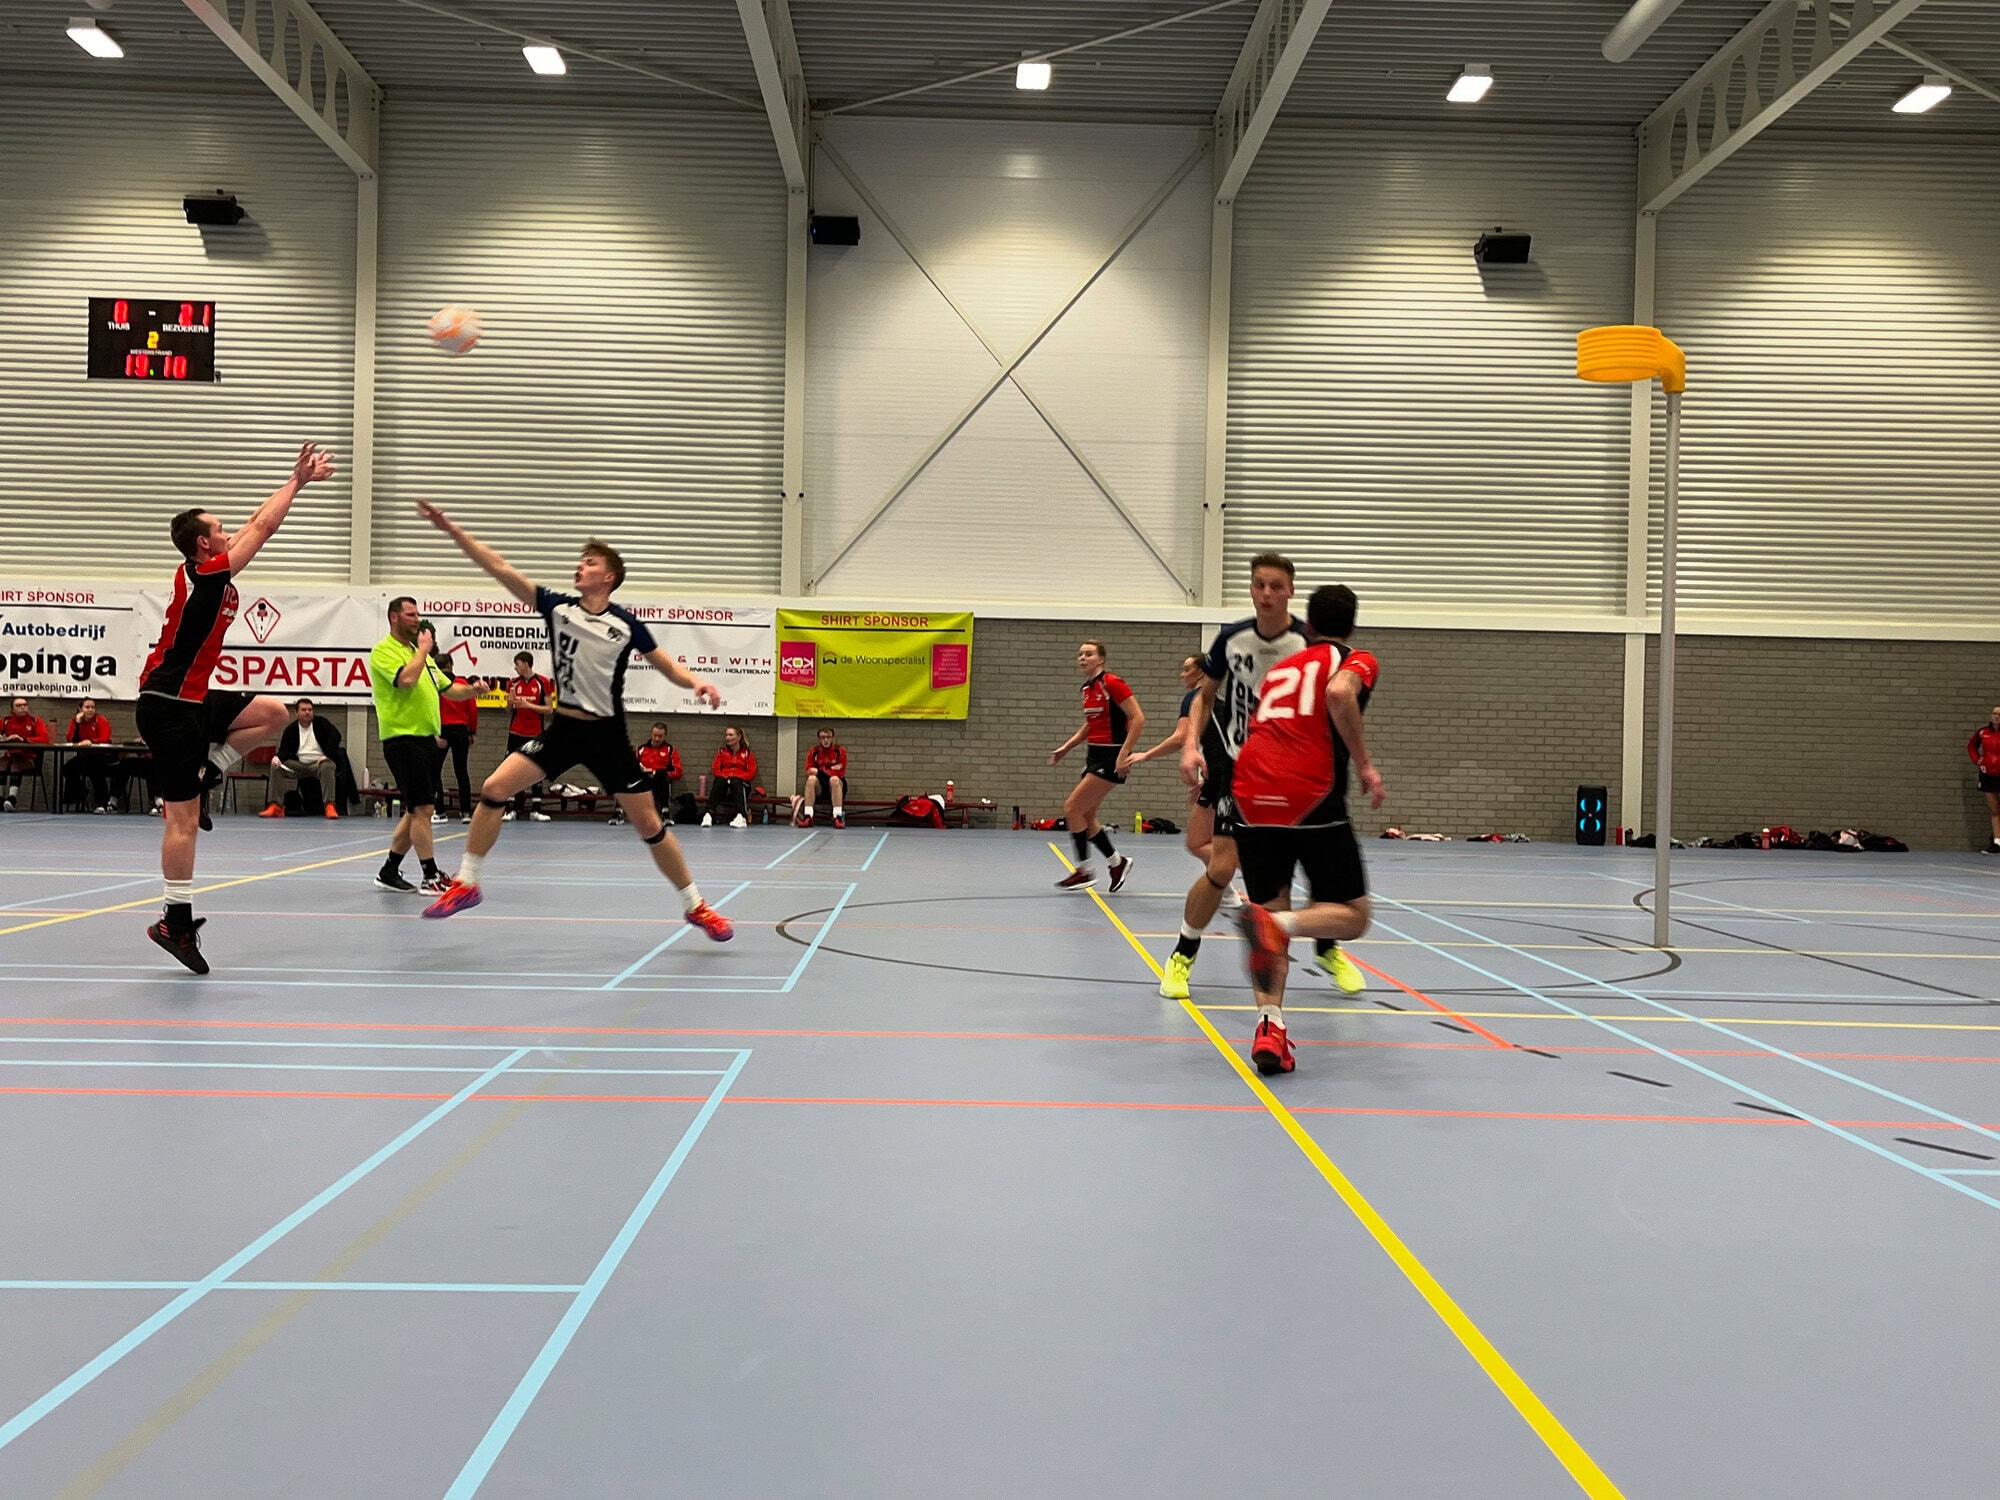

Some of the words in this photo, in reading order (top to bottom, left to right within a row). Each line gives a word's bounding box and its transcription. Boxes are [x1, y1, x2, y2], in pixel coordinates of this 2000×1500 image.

[147, 331, 159, 349] 2
[27, 591, 95, 604] SPONSOR
[423, 601, 471, 613] HOOFD
[625, 607, 664, 619] SHIRT
[668, 608, 733, 621] SPONSOR
[821, 614, 860, 626] SHIRT
[864, 616, 929, 627] SPONSOR
[2, 622, 106, 641] Autobedrijf
[729, 657, 772, 666] WITH
[782, 656, 814, 668] KOK
[840, 654, 853, 665] de
[856, 655, 926, 666] Woonspecialist
[1233, 652, 1254, 673] 24
[215, 655, 372, 688] SPARTA
[1256, 660, 1321, 723] 21
